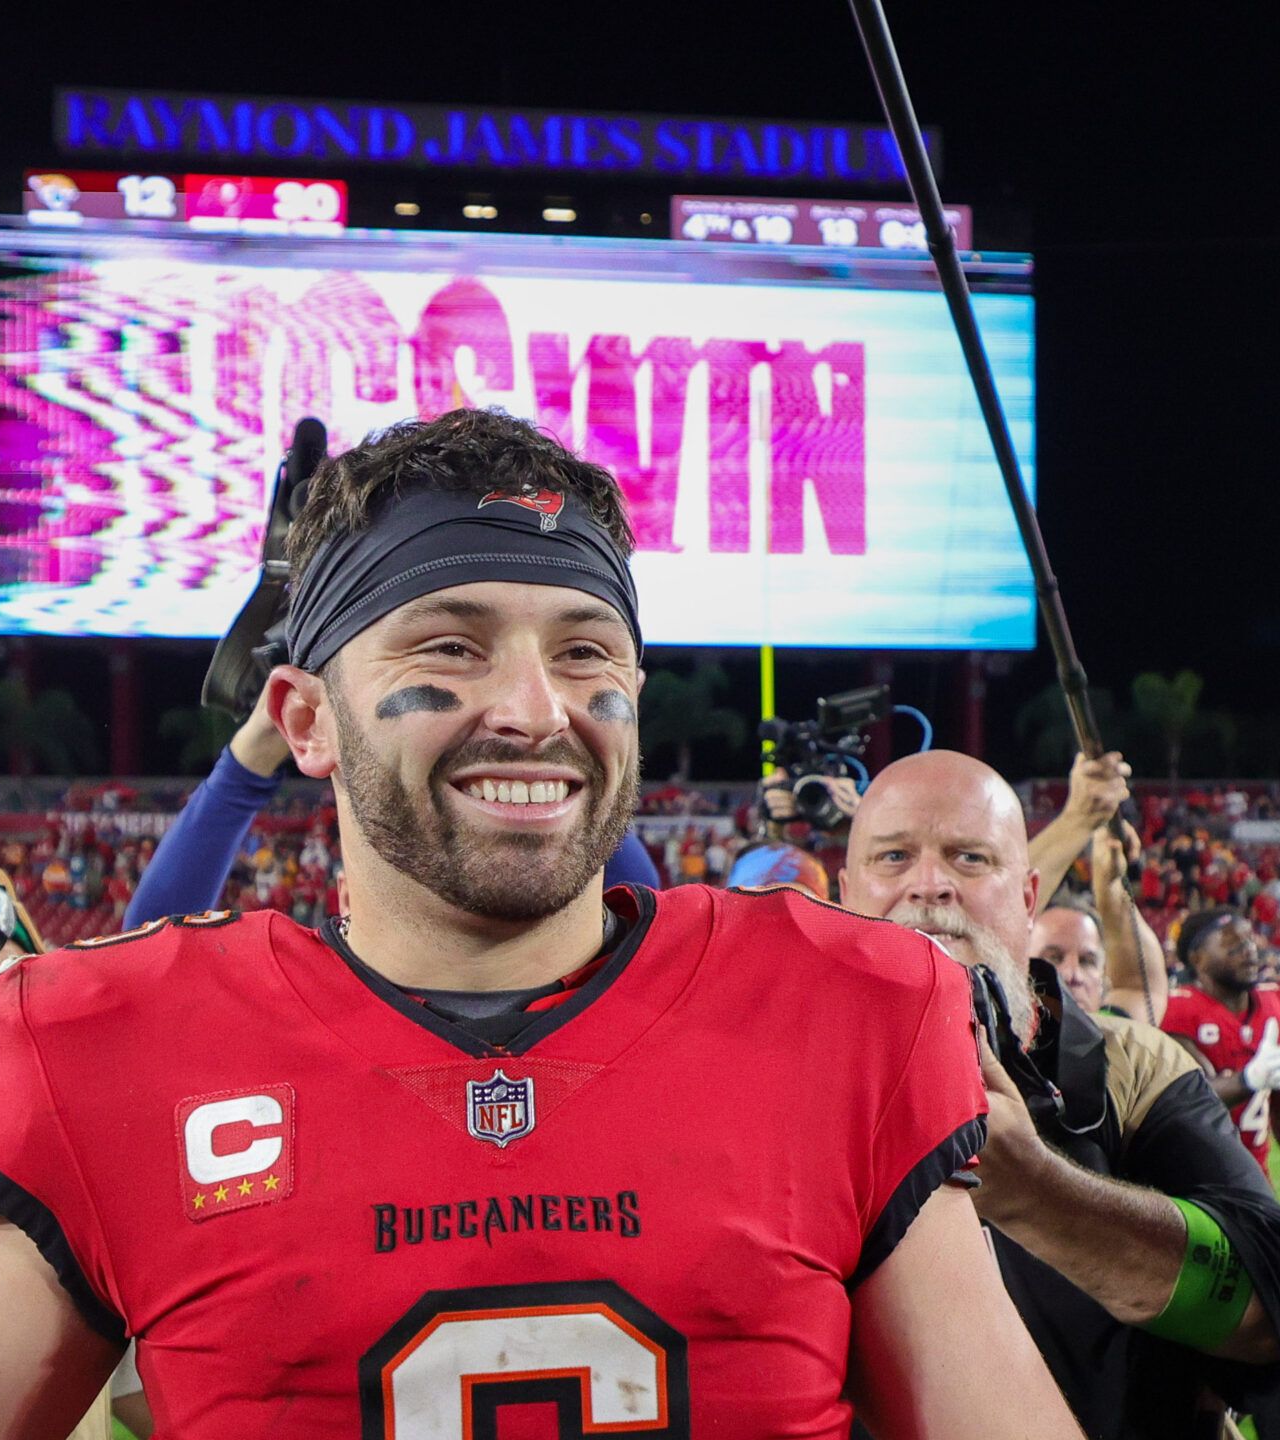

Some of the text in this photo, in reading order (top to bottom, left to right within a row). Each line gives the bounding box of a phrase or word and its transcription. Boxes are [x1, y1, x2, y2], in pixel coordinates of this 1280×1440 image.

[64, 92, 418, 162] RAYMOND
[425, 108, 641, 169] JAMES
[118, 175, 176, 217] 12
[184, 1094, 284, 1185] C
[478, 1103, 524, 1134] NFL
[372, 1190, 642, 1254] BUCCANEERS
